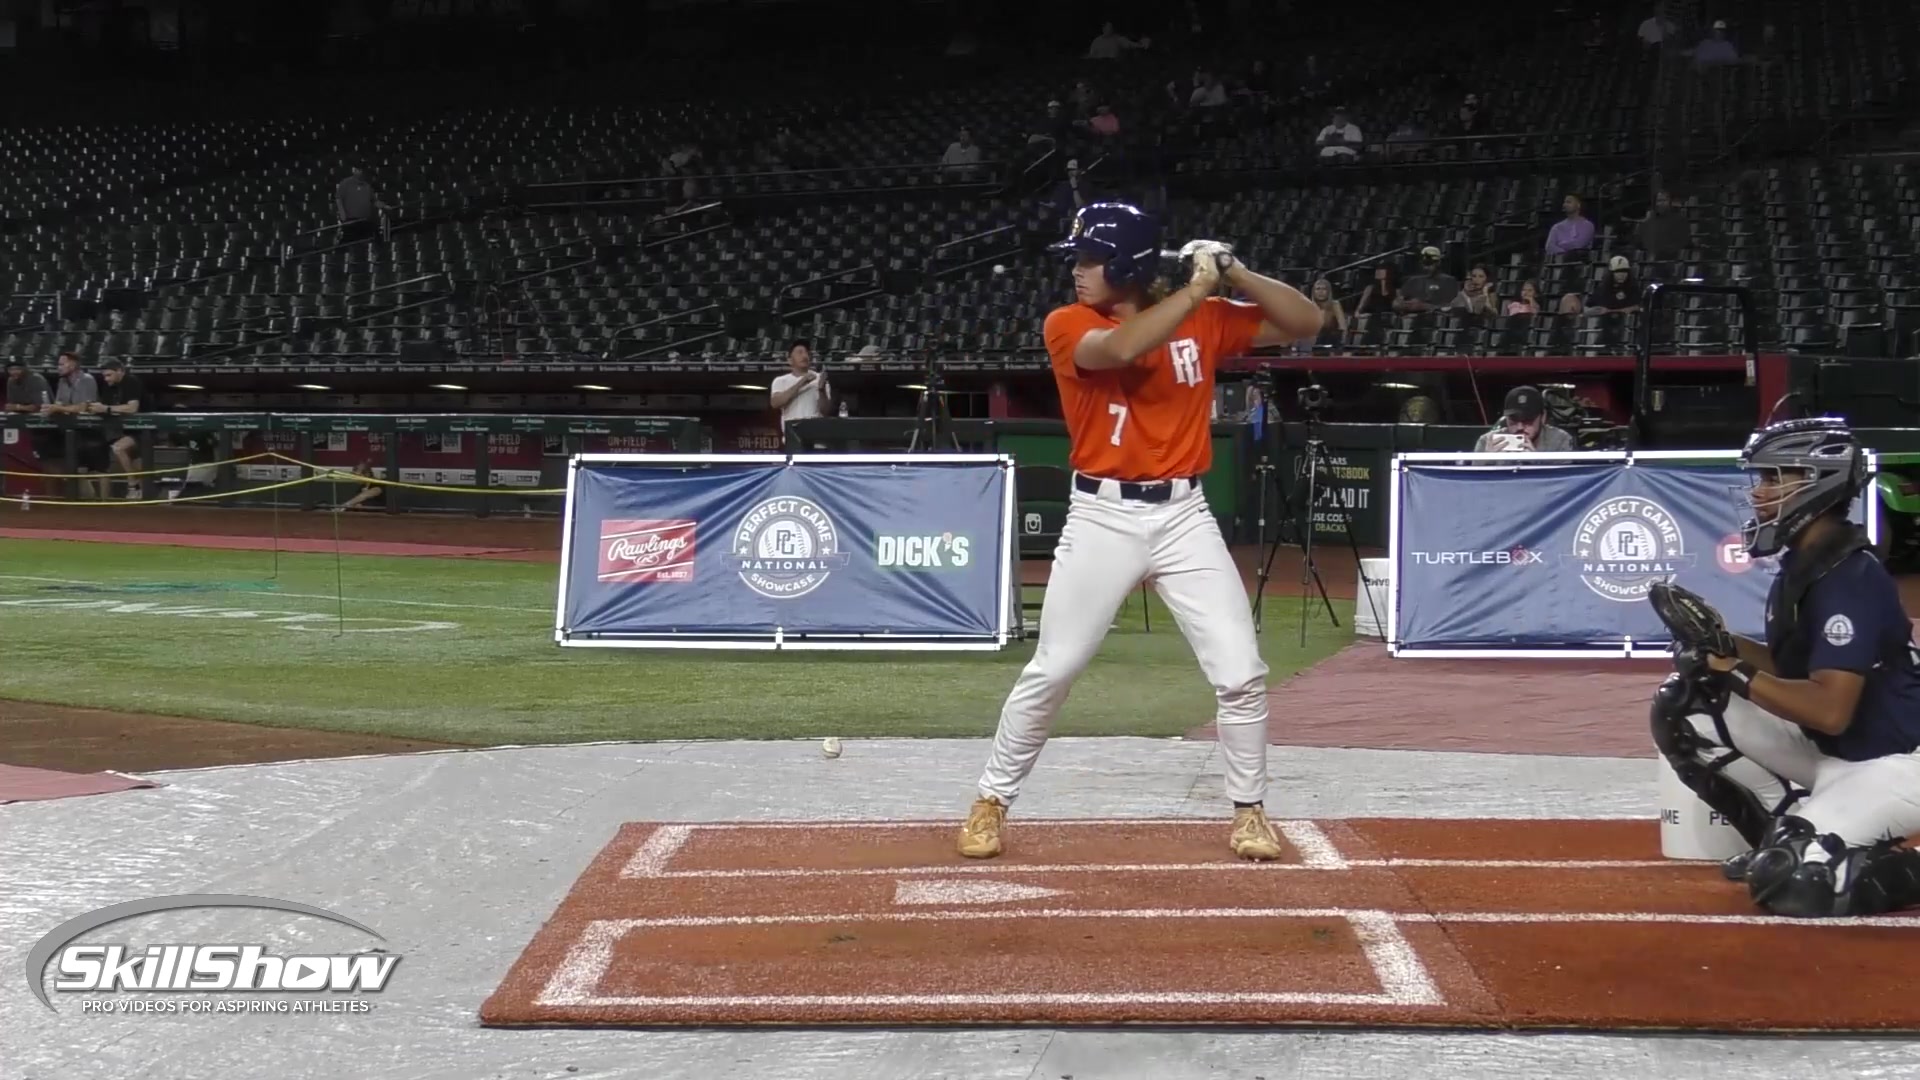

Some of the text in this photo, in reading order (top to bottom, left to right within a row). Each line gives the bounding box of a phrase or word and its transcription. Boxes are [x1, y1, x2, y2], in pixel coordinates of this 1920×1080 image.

[1108, 403, 1128, 446] 7
[488, 434, 521, 445] N-FIELD
[738, 437, 780, 449] ON-FIELD
[739, 500, 833, 543] PERFECT GAME
[1579, 501, 1678, 544] PERFECT GAME
[607, 534, 688, 562] Rawlings
[878, 532, 970, 567] DICK'S
[741, 560, 828, 570] NATIONAL
[1583, 563, 1675, 573] NATIONAL
[750, 572, 816, 592] SHOWCASE
